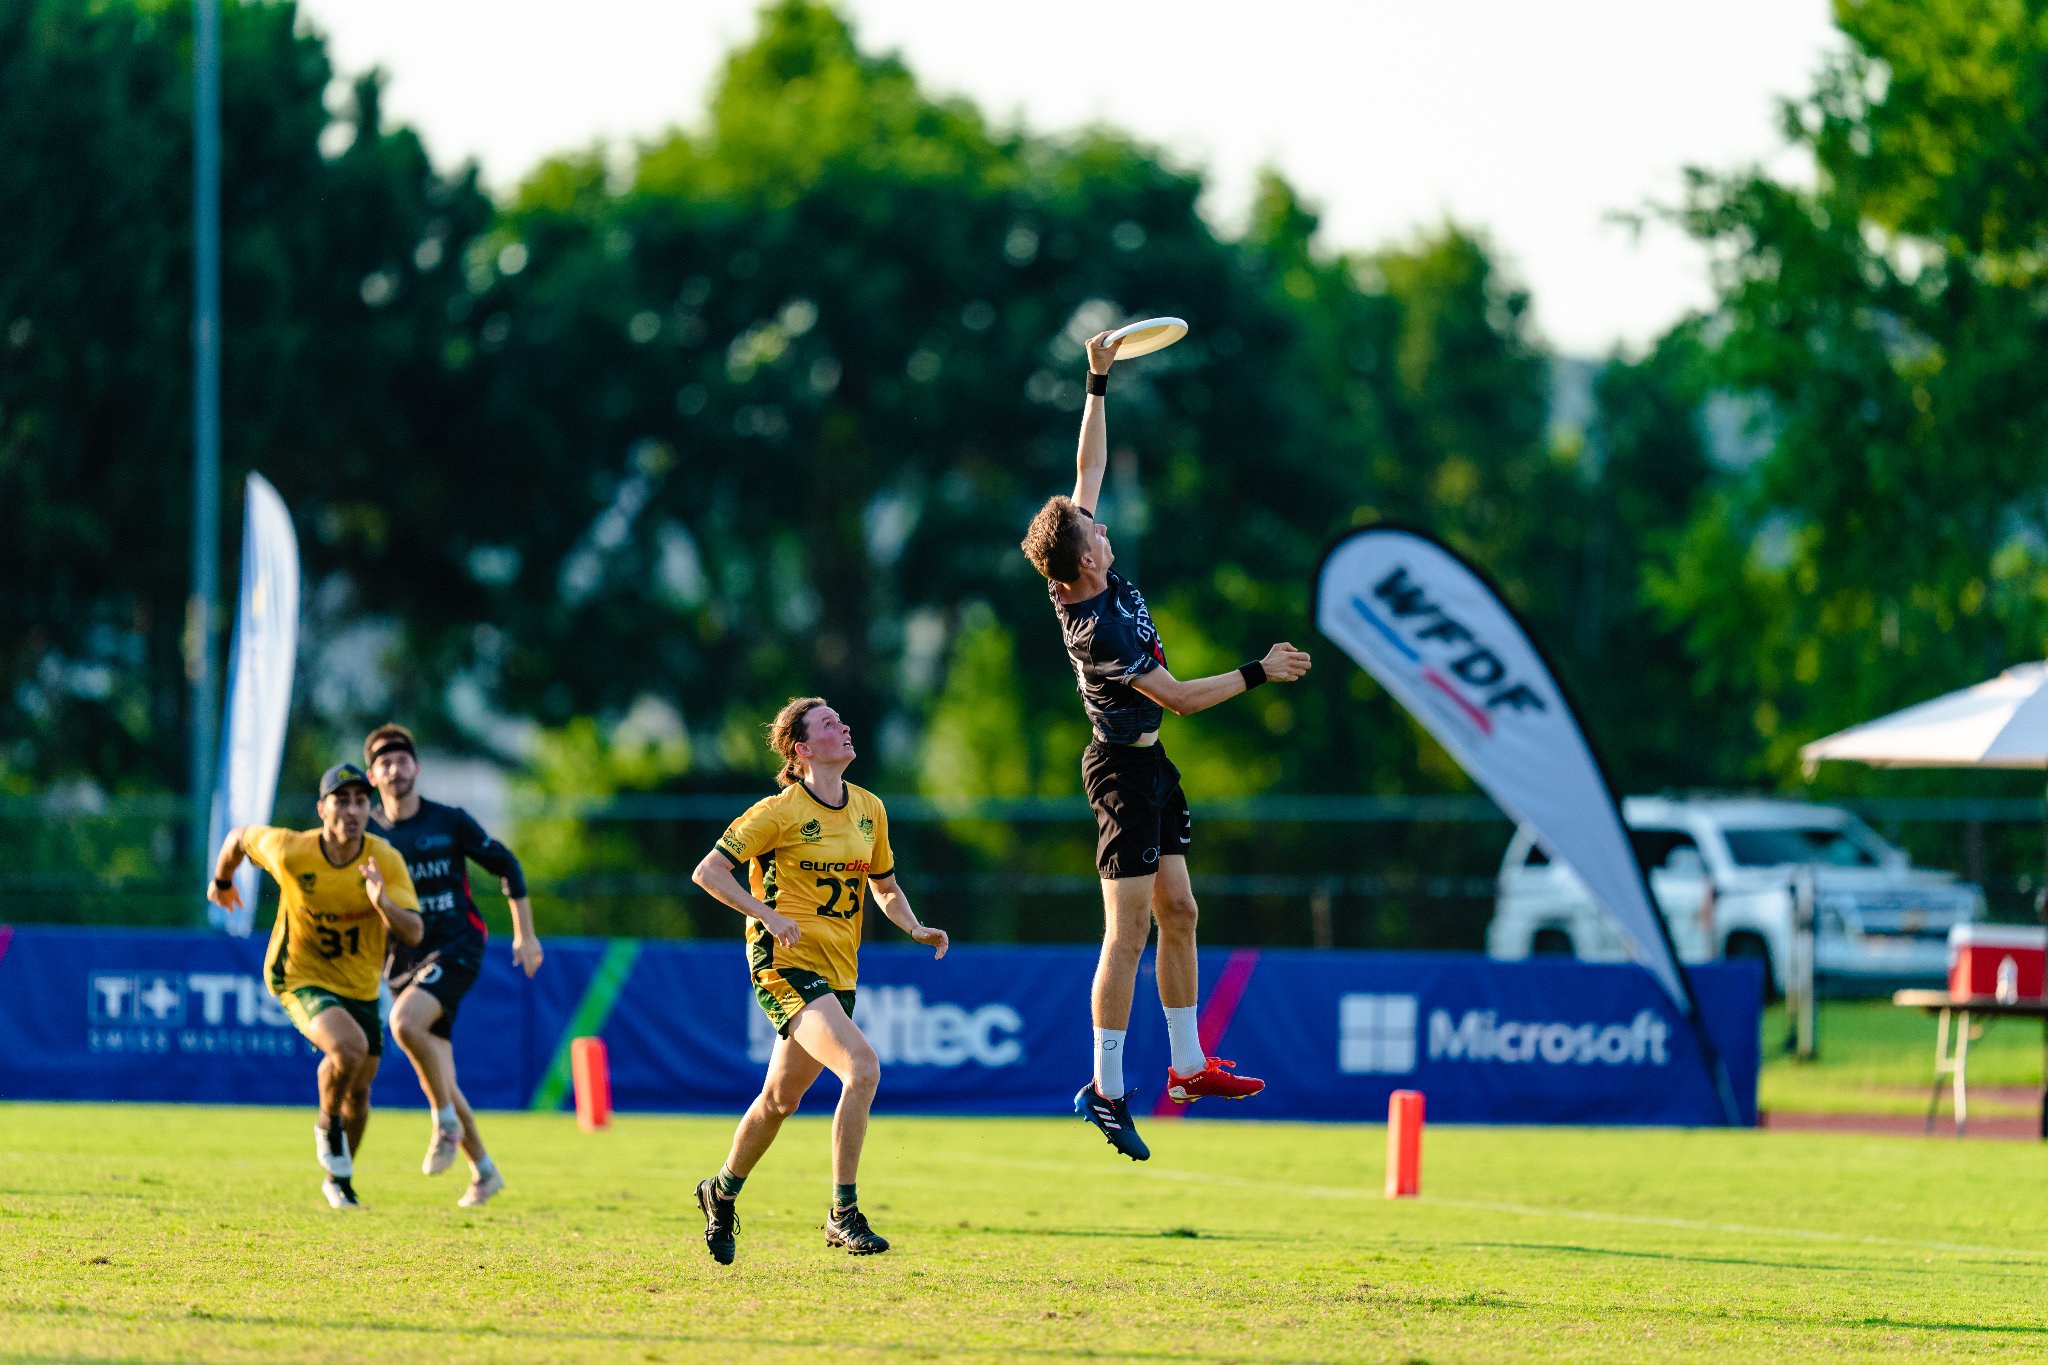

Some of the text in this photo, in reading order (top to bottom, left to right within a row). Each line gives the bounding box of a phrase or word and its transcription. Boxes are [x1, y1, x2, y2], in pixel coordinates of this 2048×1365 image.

[1374, 566, 1546, 712] WFDF
[816, 877, 860, 919] 23
[315, 926, 360, 959] 31
[188, 974, 293, 1026] TIS
[1428, 1008, 1669, 1064] Microsoft
[1188, 1075, 1204, 1085] COPA
